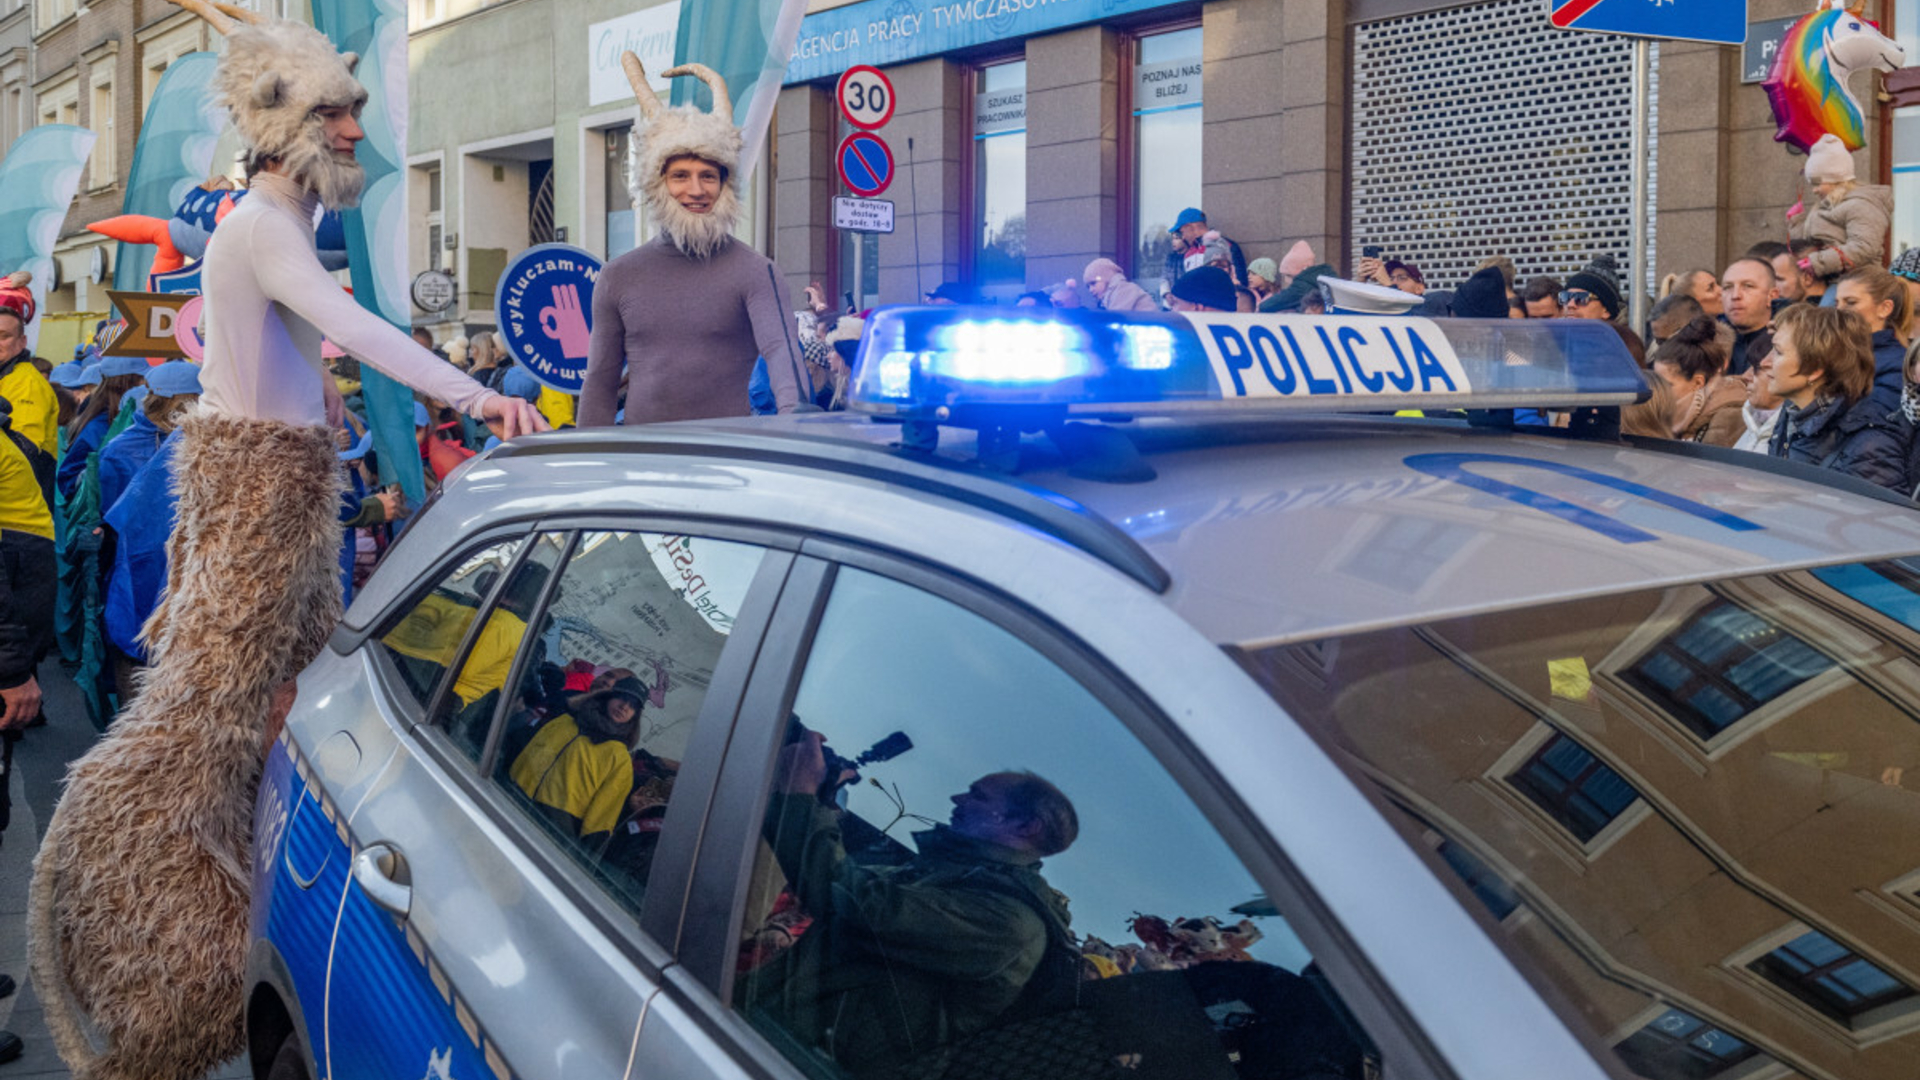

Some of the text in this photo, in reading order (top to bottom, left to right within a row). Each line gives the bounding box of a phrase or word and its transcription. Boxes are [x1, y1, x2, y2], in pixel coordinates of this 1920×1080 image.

[790, 0, 1068, 61] AGENCJA PRACY TYMCZAS
[1142, 64, 1202, 83] POZNAJ NAS
[848, 81, 885, 112] 30
[1156, 82, 1188, 98] BLIŻEJ
[987, 93, 1023, 109] SZUKASZ
[842, 199, 888, 212] Nie dotyczy
[851, 210, 878, 218] dostaw
[507, 259, 574, 375] Nie wykluczam
[1207, 324, 1457, 396] POLICJA
